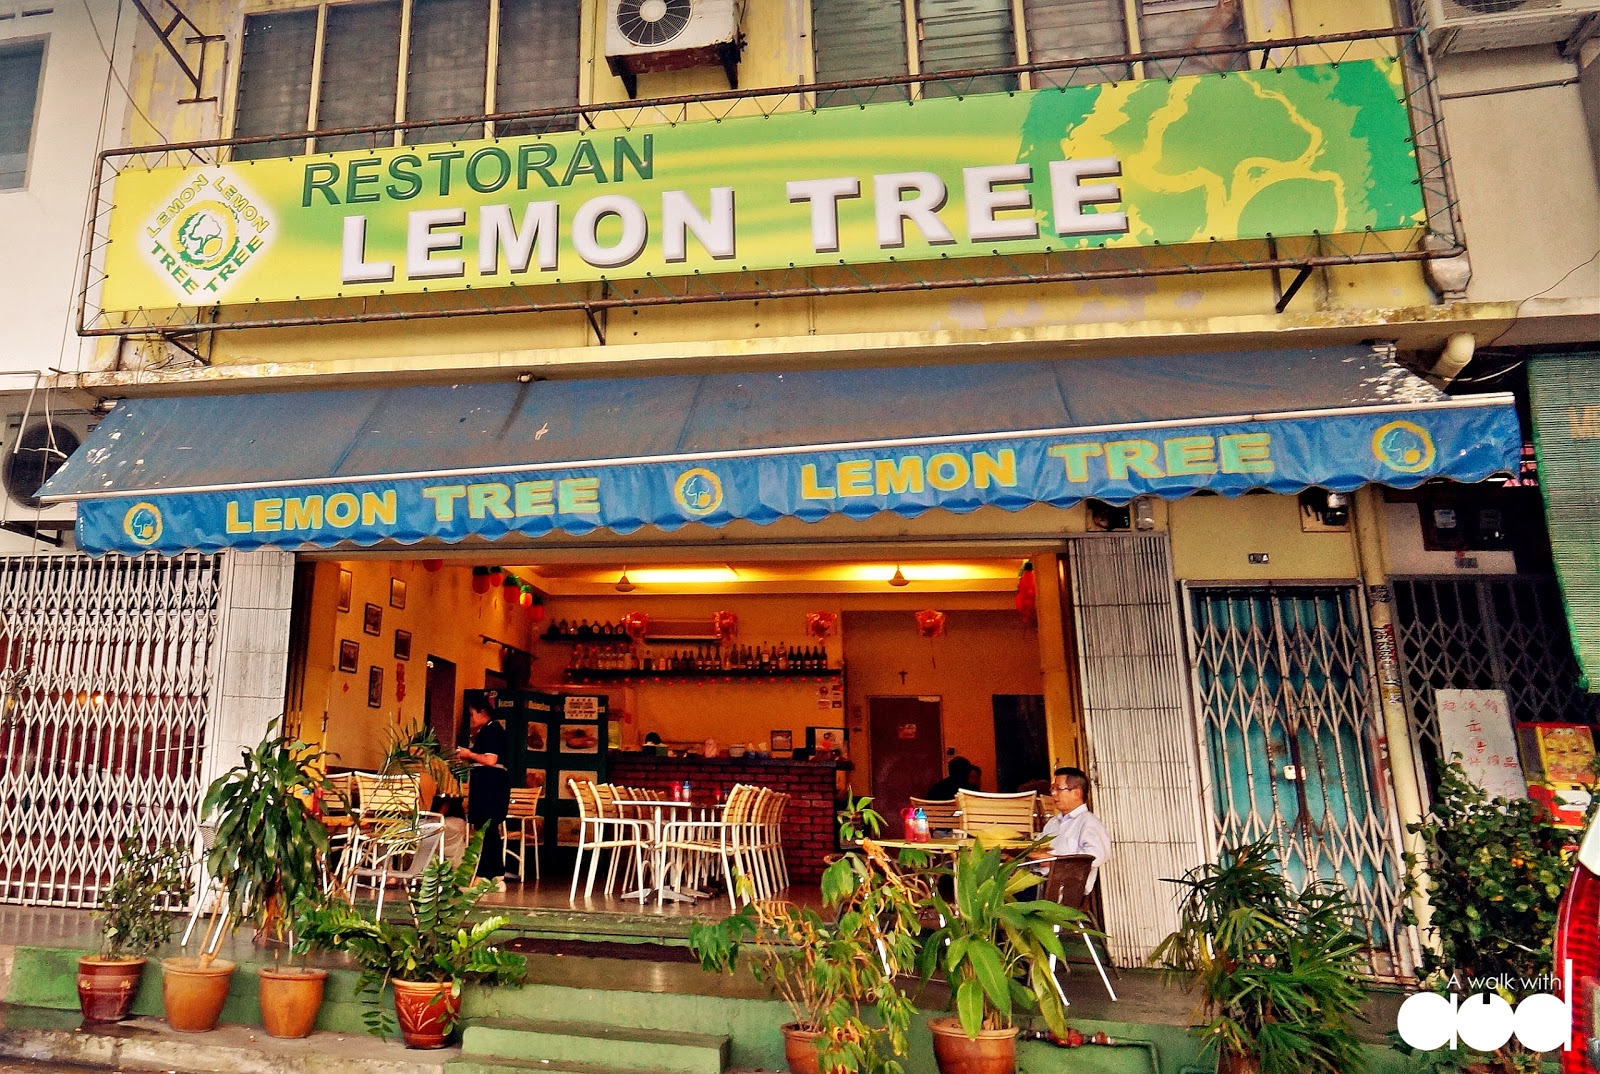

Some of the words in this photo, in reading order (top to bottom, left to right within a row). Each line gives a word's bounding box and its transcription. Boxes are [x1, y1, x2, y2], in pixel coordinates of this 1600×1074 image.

[302, 134, 654, 207] RESTORAN
[146, 174, 209, 238] LEMON
[213, 176, 270, 233] LEMON
[342, 187, 736, 284] LEMON
[786, 157, 1129, 254] TREE
[151, 240, 199, 295] TREE
[203, 235, 264, 292] TREE
[801, 449, 1017, 499] LEMON
[1048, 433, 1274, 482] TREE
[226, 490, 397, 534] LEMON
[422, 477, 600, 522] TREE
